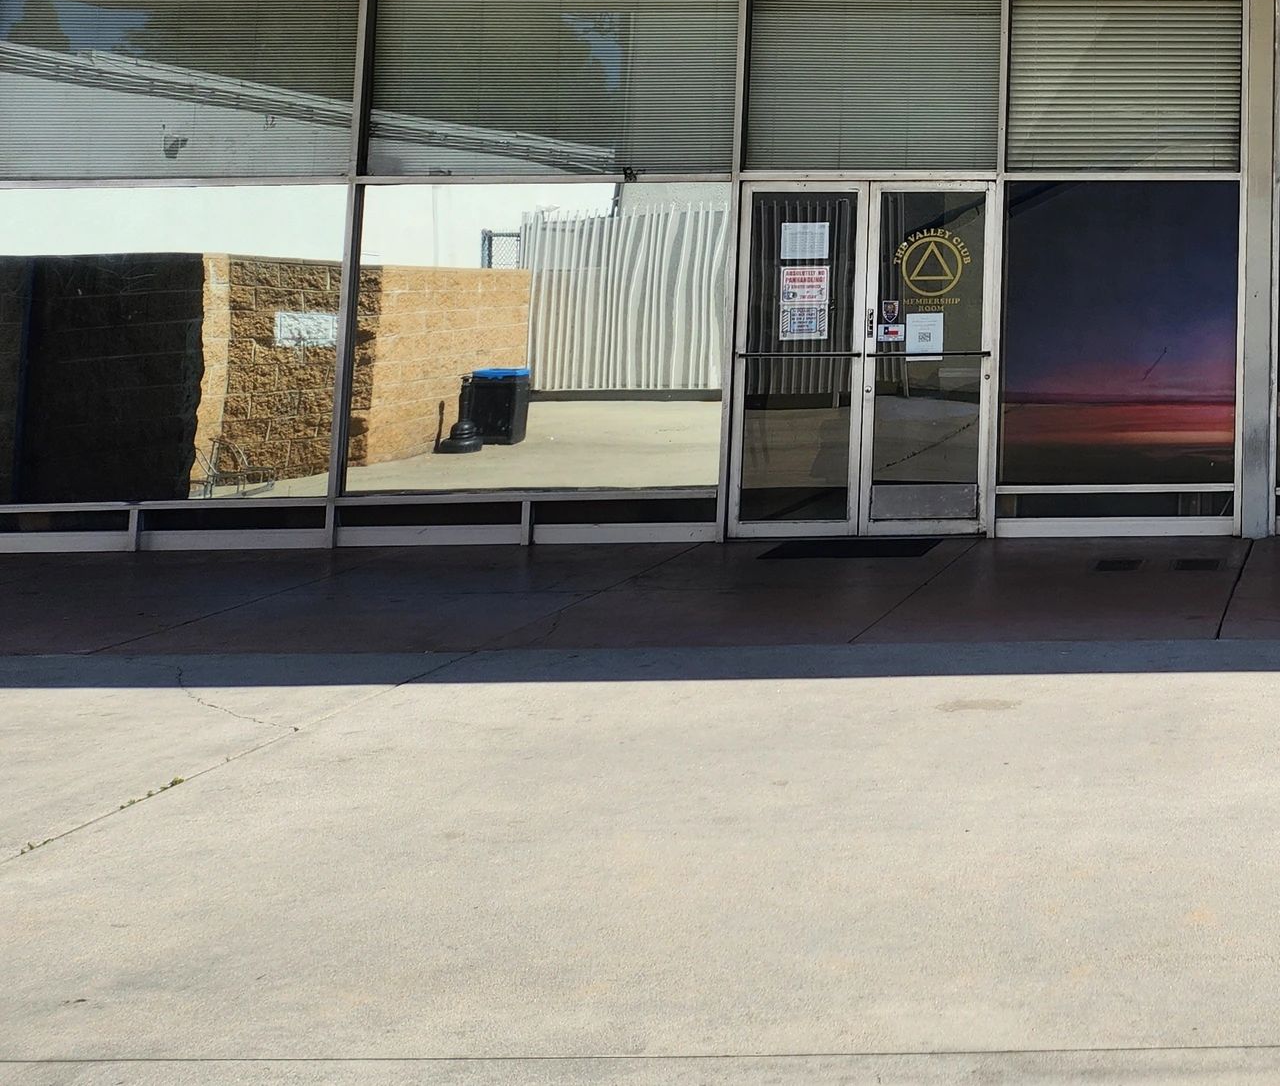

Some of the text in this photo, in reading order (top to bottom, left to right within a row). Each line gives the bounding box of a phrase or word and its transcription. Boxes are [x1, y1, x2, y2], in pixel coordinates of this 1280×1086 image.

[893, 228, 972, 265] THE VALLEY CLUB
